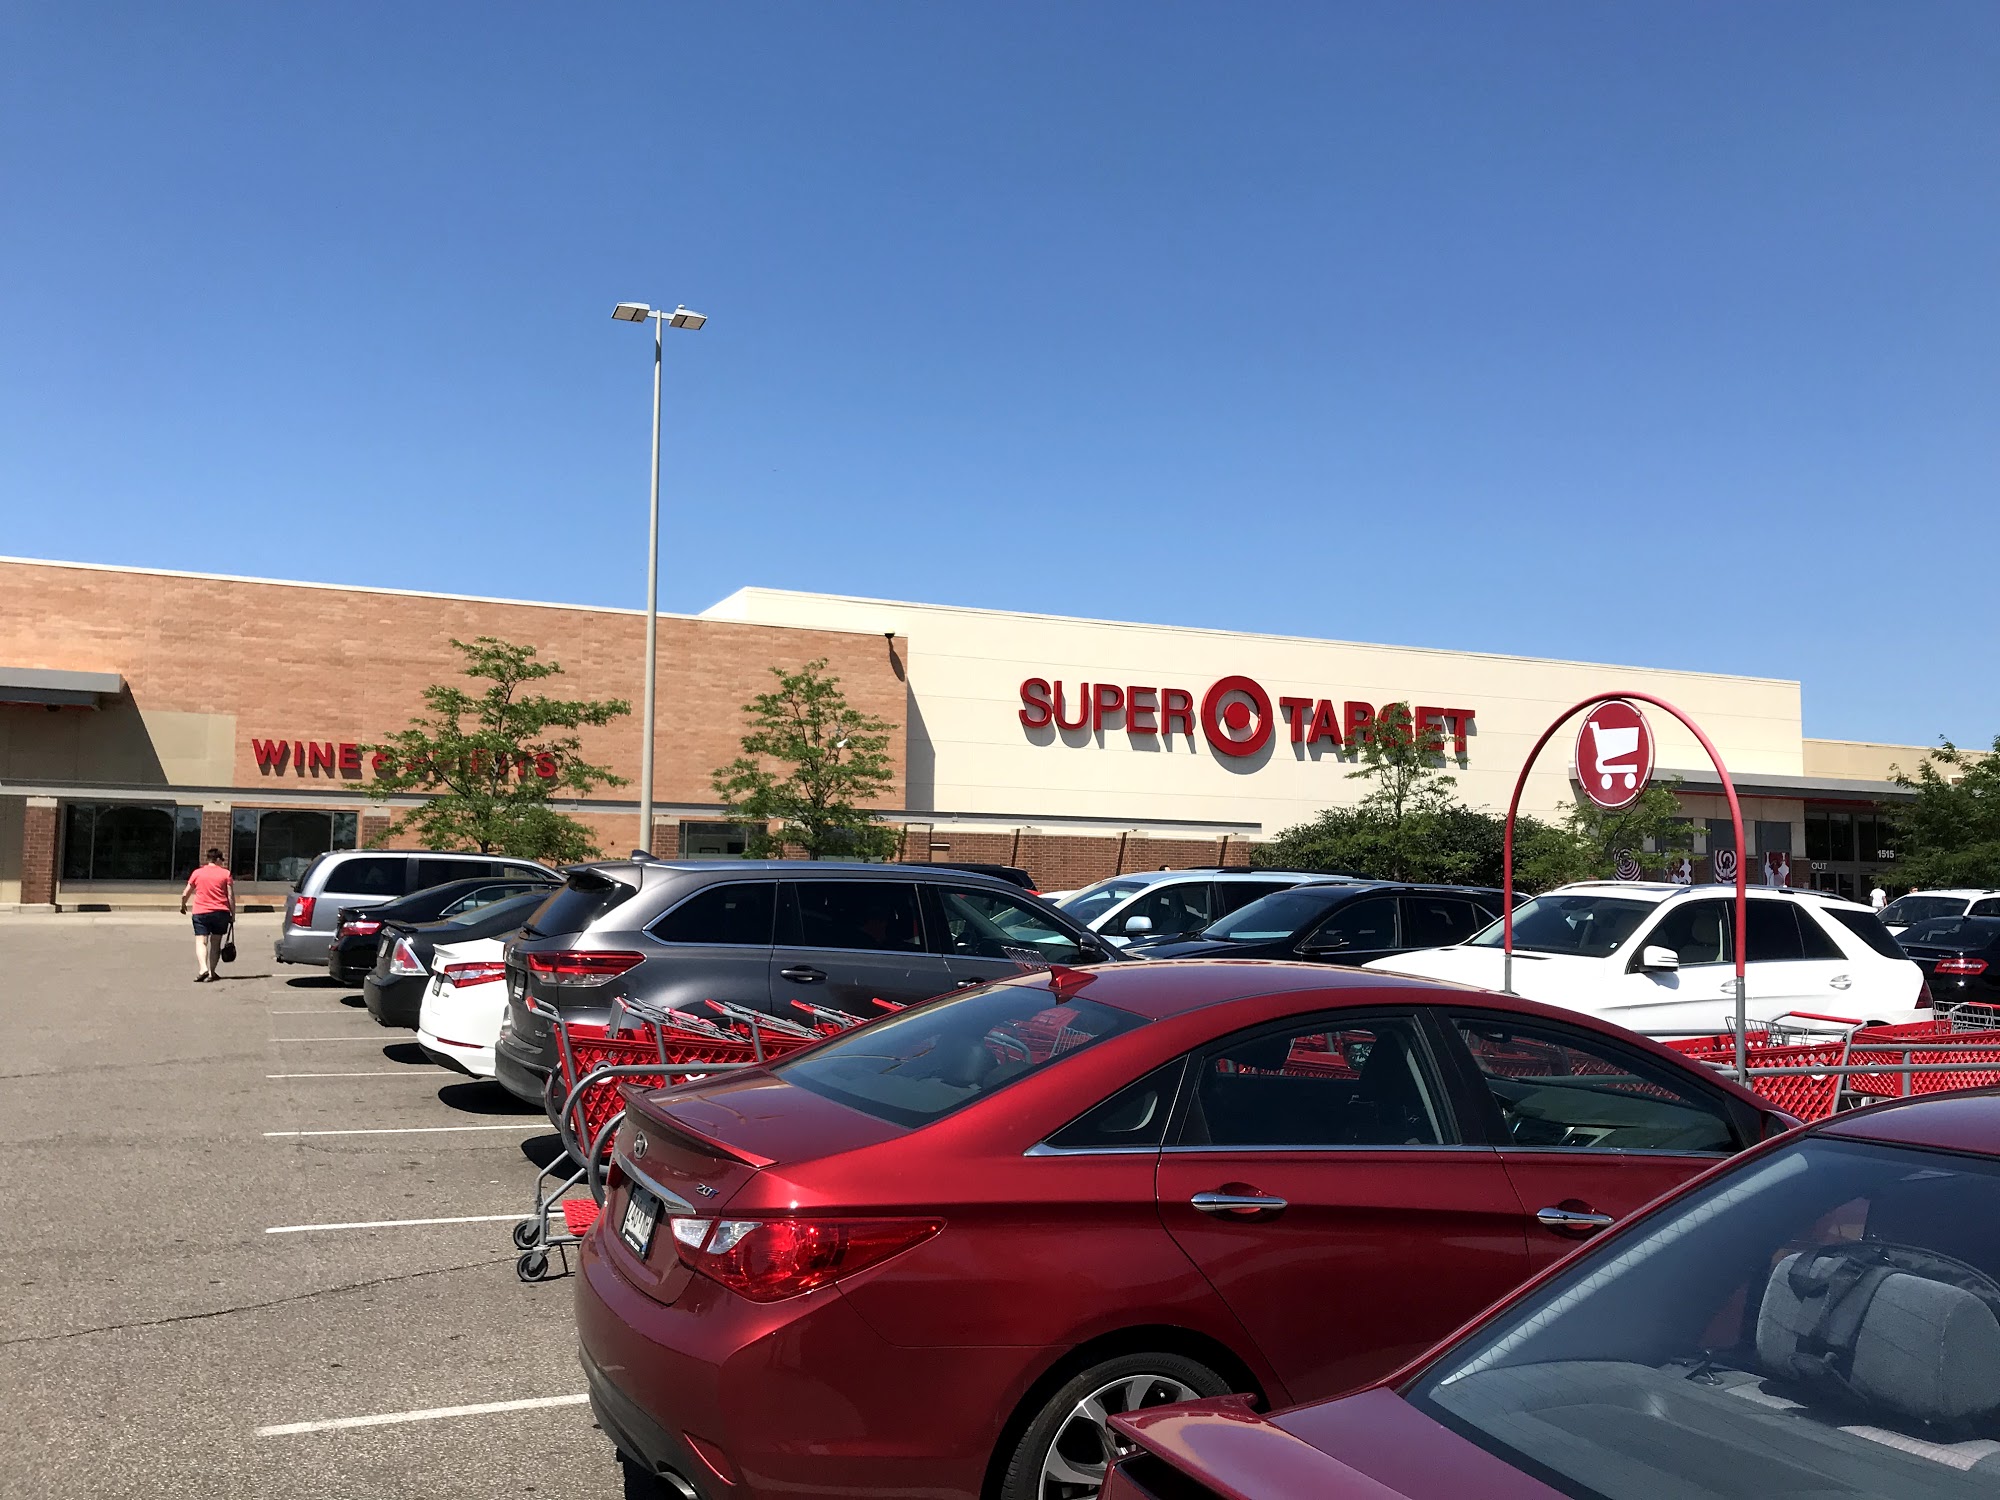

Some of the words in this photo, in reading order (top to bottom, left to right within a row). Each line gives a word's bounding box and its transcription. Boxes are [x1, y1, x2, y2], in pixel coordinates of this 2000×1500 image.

[1018, 677, 1194, 736] SUPER
[251, 738, 360, 769] WINE
[1877, 849, 1895, 859] 1515
[1811, 861, 1828, 870] OUT
